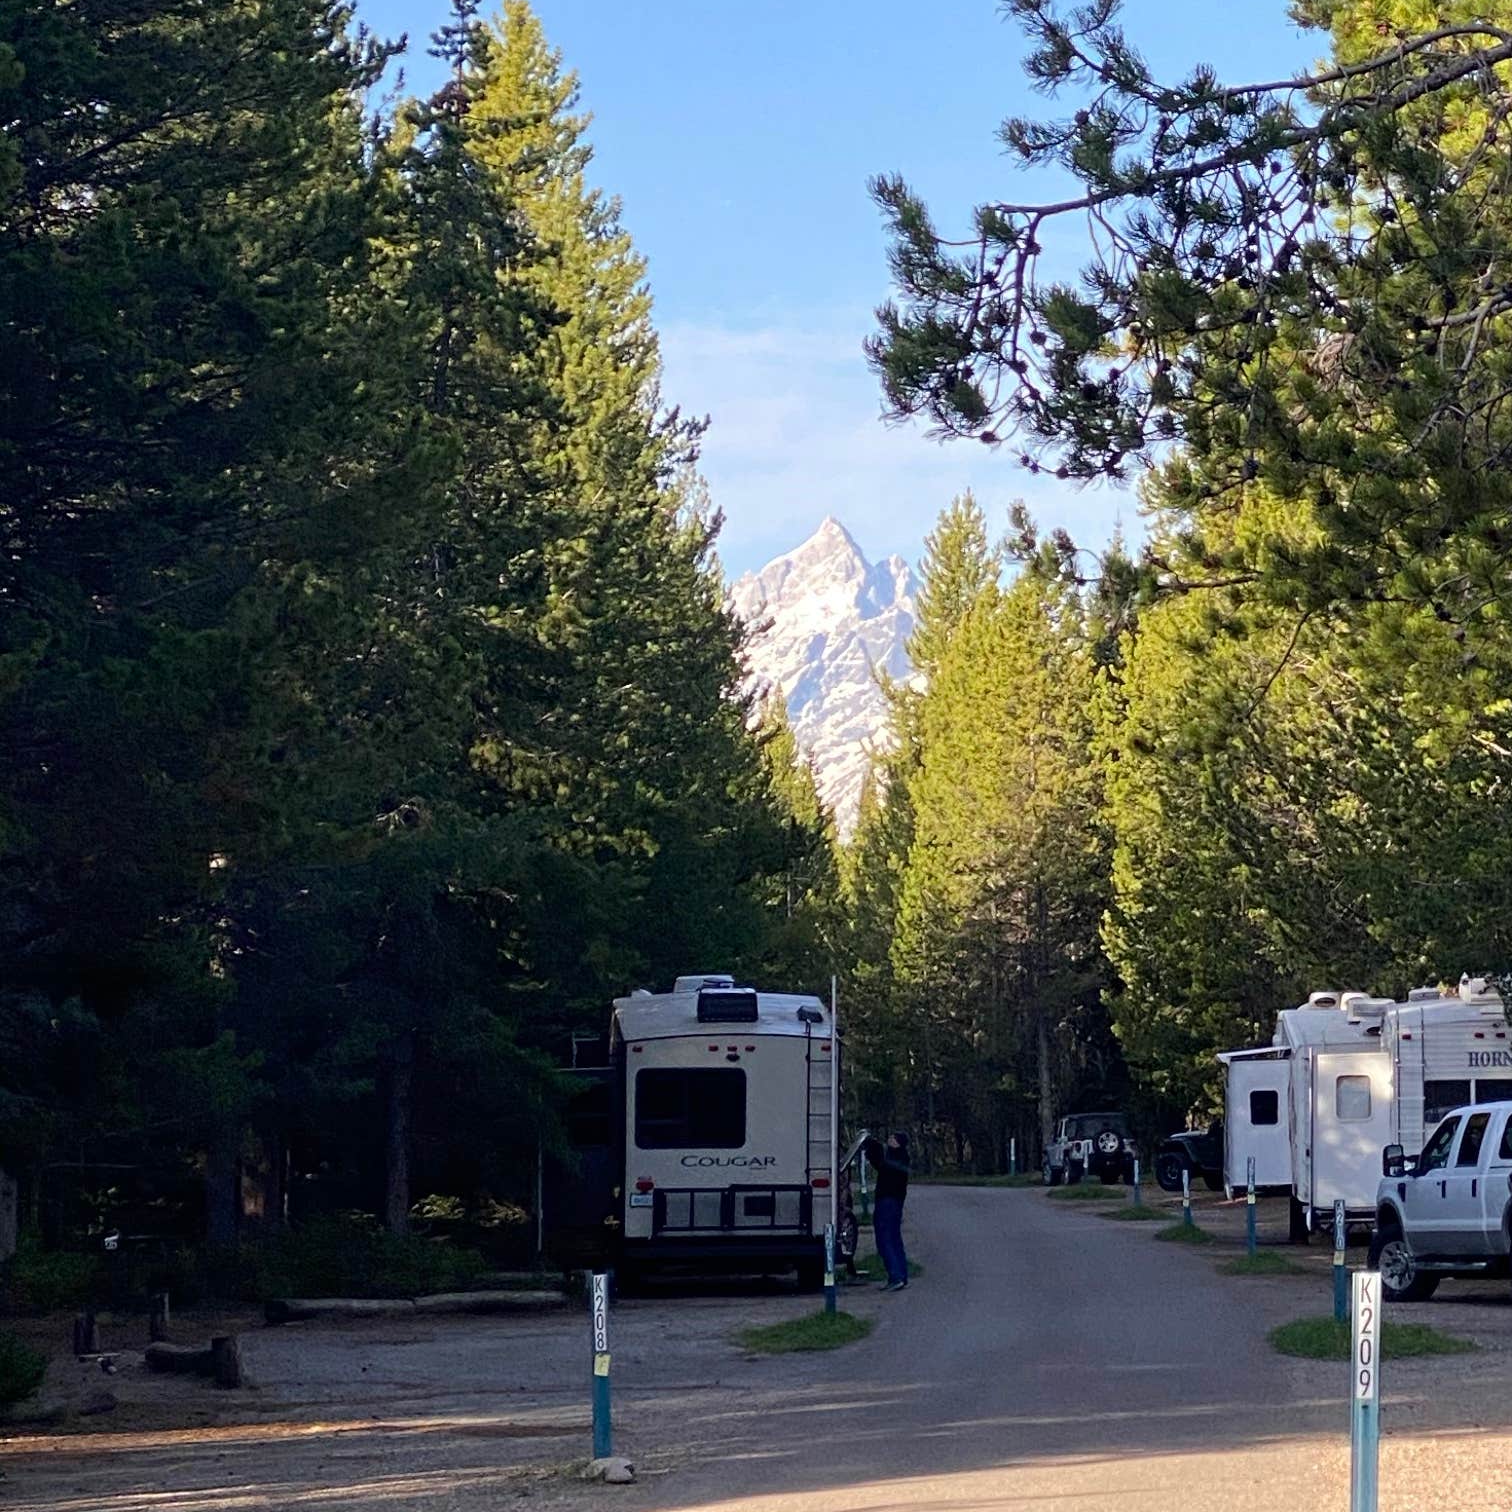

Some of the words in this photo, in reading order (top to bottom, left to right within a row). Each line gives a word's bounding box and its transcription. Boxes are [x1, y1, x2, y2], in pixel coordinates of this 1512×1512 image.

[680, 1155, 777, 1168] COUGAR
[594, 1277, 605, 1349] K208
[1359, 1277, 1374, 1396] K209
